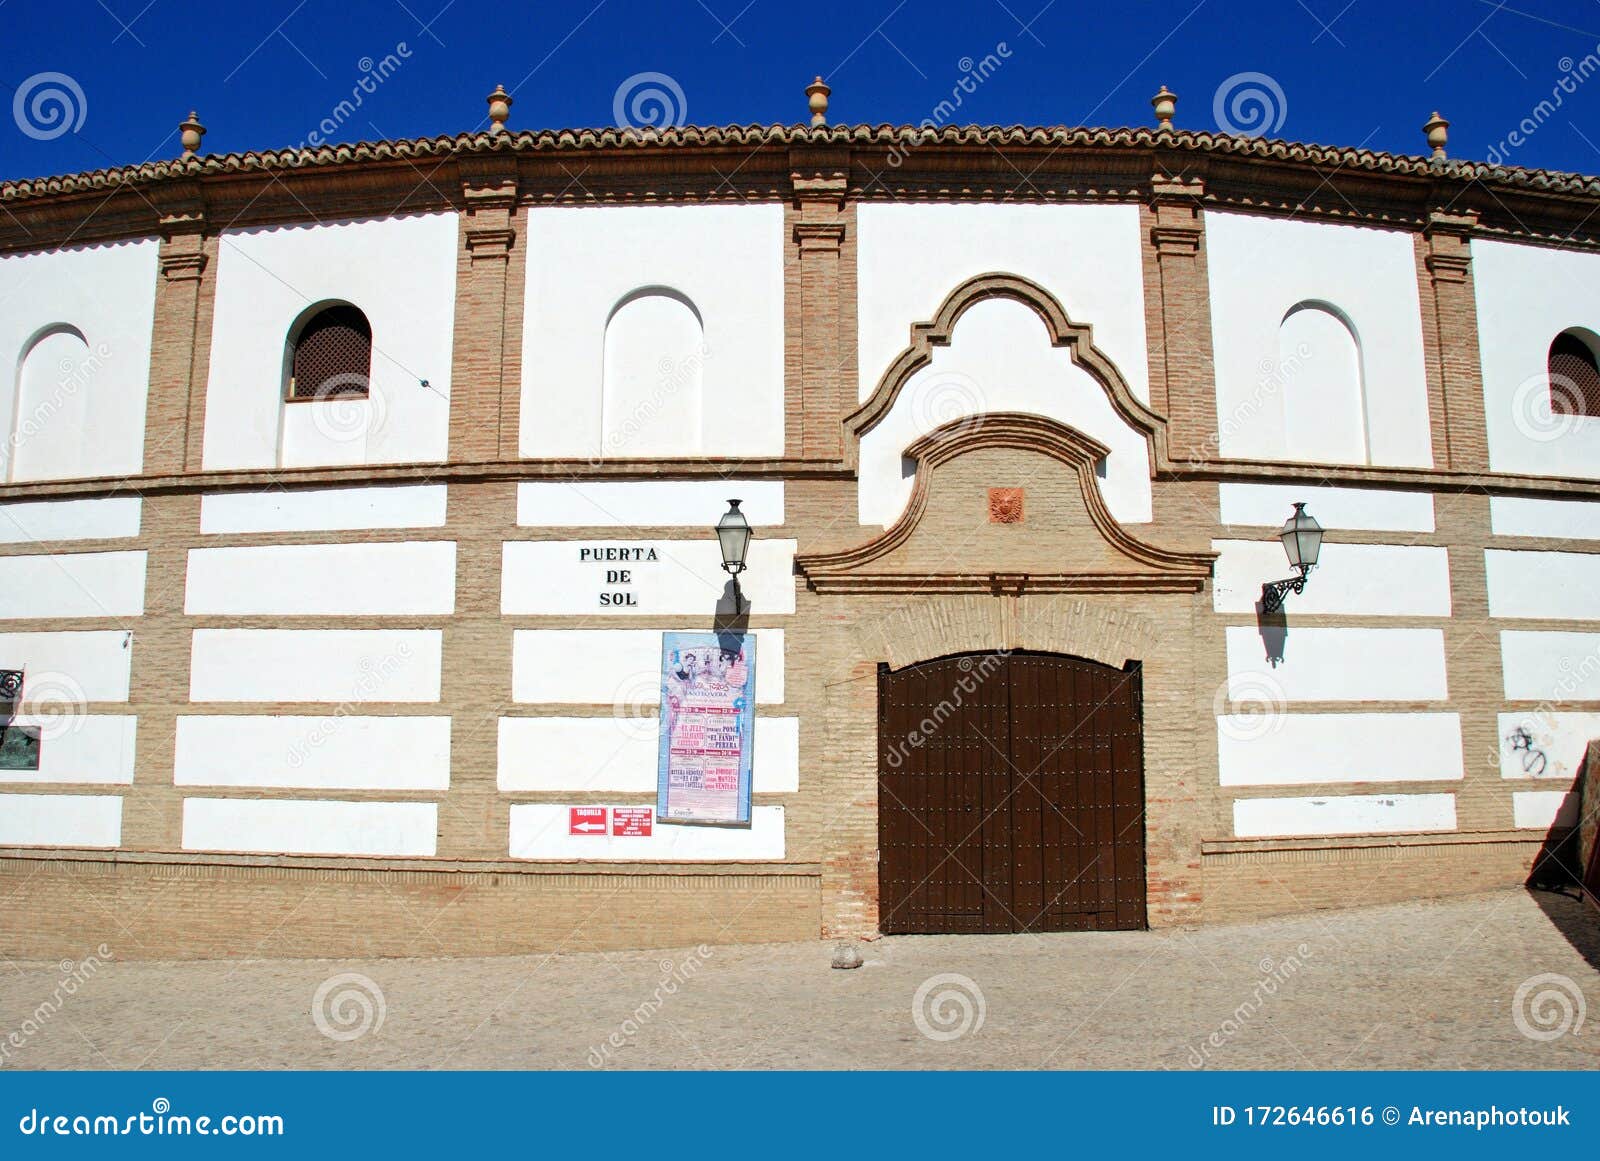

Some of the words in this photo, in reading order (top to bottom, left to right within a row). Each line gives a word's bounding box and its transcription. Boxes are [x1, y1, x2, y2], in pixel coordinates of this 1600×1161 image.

[580, 548, 658, 561] PUERTA
[607, 570, 631, 583] DE
[600, 593, 637, 606] SOL
[576, 808, 602, 816] TAQUILLA
